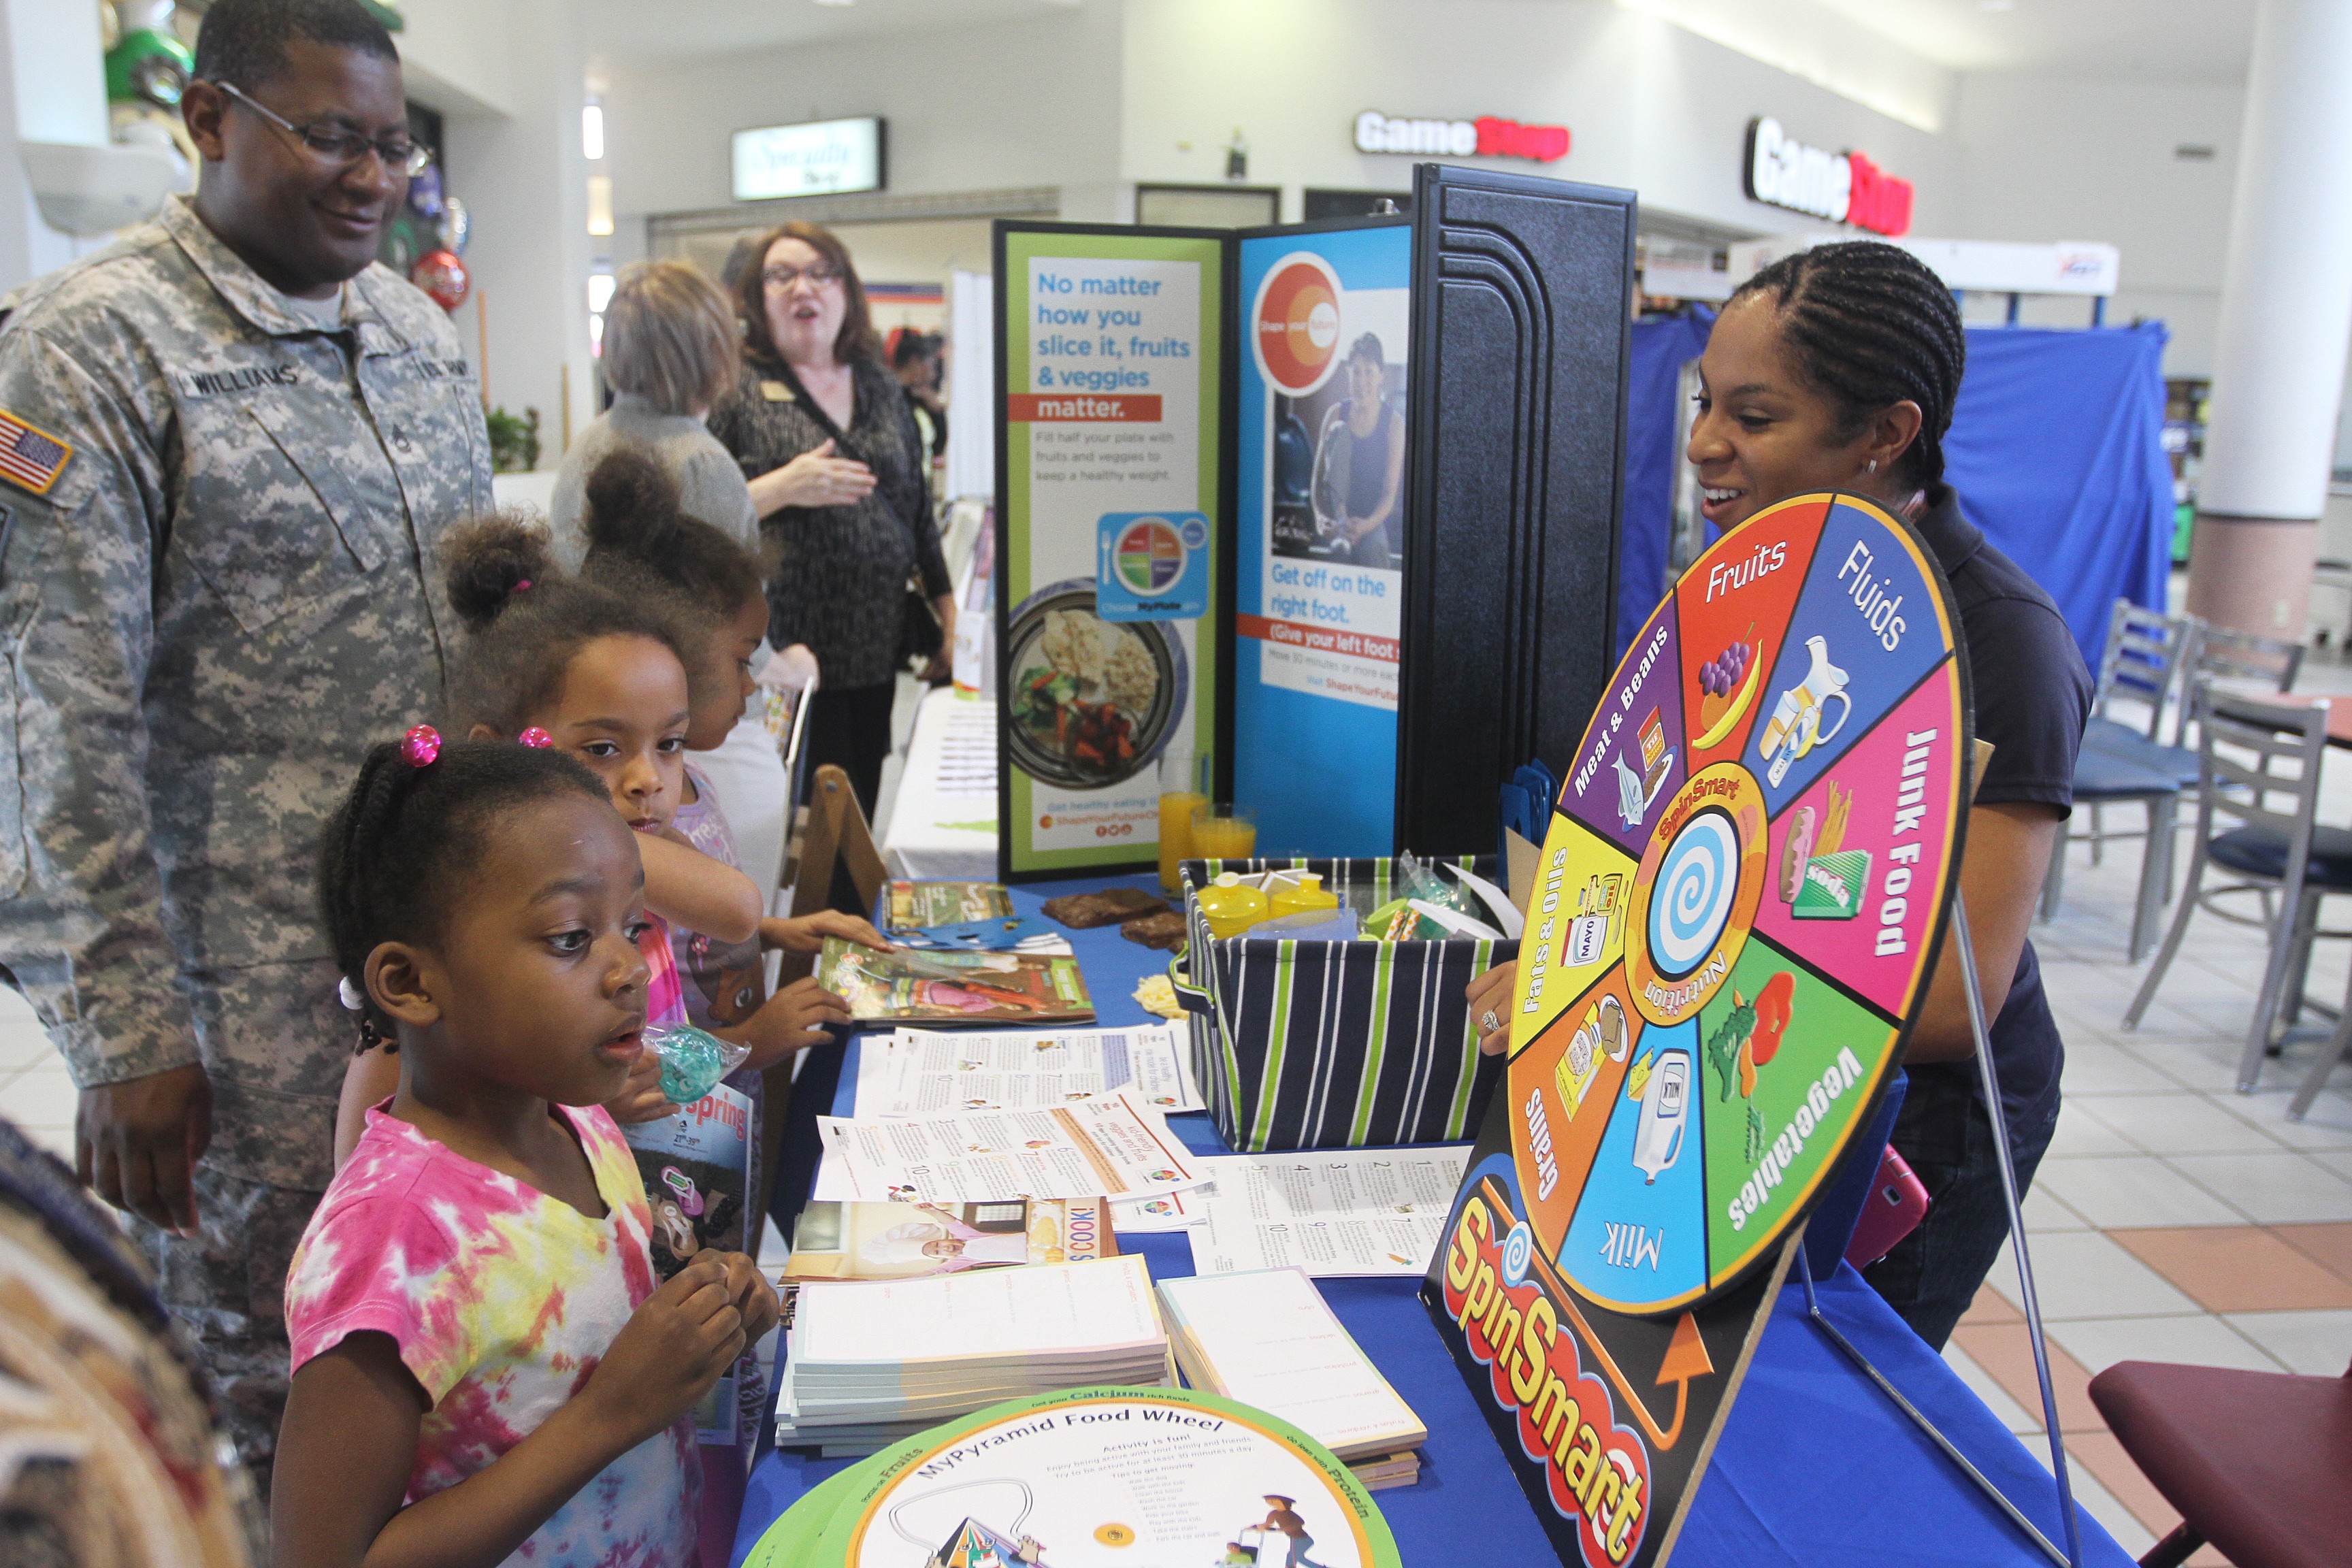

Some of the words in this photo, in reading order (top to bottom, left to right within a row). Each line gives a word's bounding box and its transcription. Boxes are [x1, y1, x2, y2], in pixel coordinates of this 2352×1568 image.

[1037, 274, 1073, 293] No
[1081, 278, 1162, 295] matter
[1037, 306, 1090, 325] how
[1098, 310, 1141, 331] you
[1037, 337, 1092, 356] slice
[1100, 337, 1122, 359] it,
[1130, 337, 1190, 357] fruits
[191, 364, 298, 395] WILLIAMS
[1038, 368, 1054, 386] &
[1061, 368, 1150, 391] veggies
[1037, 398, 1125, 419] matter.
[1271, 564, 1299, 585] Get
[1303, 569, 1326, 588] off
[1330, 576, 1352, 592] on
[1357, 574, 1386, 597] the
[1705, 540, 1787, 603] Fruits
[1271, 593, 1307, 618] right
[1311, 599, 1350, 623] foot.
[1838, 539, 1906, 652] Fluids
[1270, 624, 1302, 642] (Give
[1305, 633, 1334, 647] your
[1337, 634, 1360, 653] left
[1365, 639, 1393, 658] foot
[1573, 738, 1610, 798] Meat
[1610, 713, 1623, 734] &
[1620, 625, 1669, 709] Beans
[1893, 728, 1938, 836] Junk
[1659, 776, 1740, 841] SpinSmart
[1542, 847, 1567, 914] Oils
[1874, 843, 1921, 957] Food
[1539, 915, 1555, 940] &
[1581, 921, 1595, 957] MAYO
[1522, 943, 1550, 1014] Fats
[1644, 950, 1727, 1017] Nutrition
[1525, 1087, 1558, 1202] Grains
[1727, 1045, 1864, 1232] Vegetables
[1069, 1208, 1095, 1251] COOK!
[1599, 1221, 1663, 1272] Milk
[1071, 1390, 1144, 1400] Calcium
[1447, 1196, 1643, 1563] SpinSmart
[880, 1447, 924, 1480] Fruits
[917, 1414, 1055, 1481] MyPyramid
[1064, 1409, 1130, 1426] Food
[1143, 1409, 1224, 1433] Wheel
[1103, 1440, 1148, 1453] Activity
[1328, 1468, 1369, 1519] Protein
